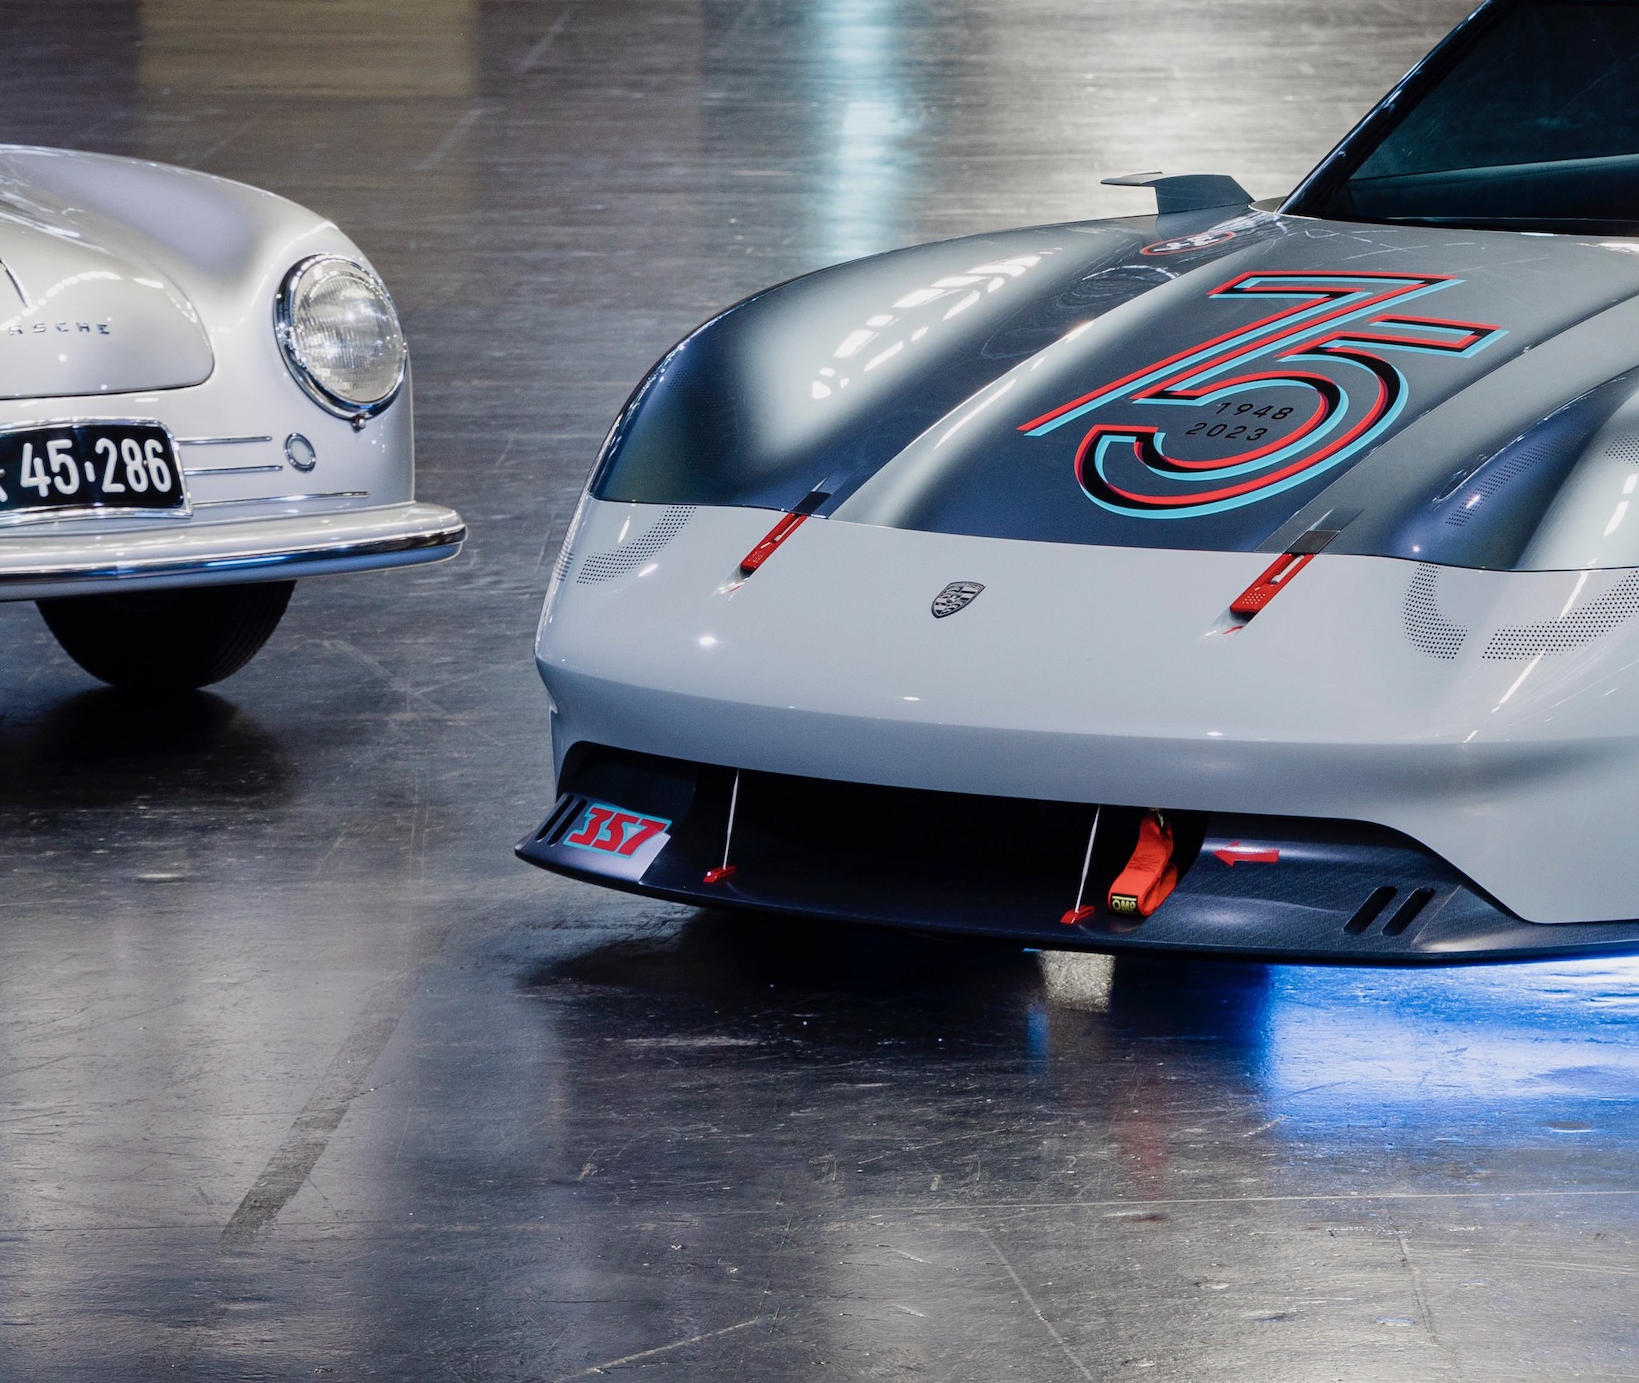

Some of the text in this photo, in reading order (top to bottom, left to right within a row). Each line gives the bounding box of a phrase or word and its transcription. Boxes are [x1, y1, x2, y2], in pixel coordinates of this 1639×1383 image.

[1017, 270, 1510, 520] 75
[1214, 401, 1295, 421] 1948
[1184, 422, 1269, 442] 2023
[563, 802, 672, 859] 357
[1111, 898, 1137, 912] OMP
